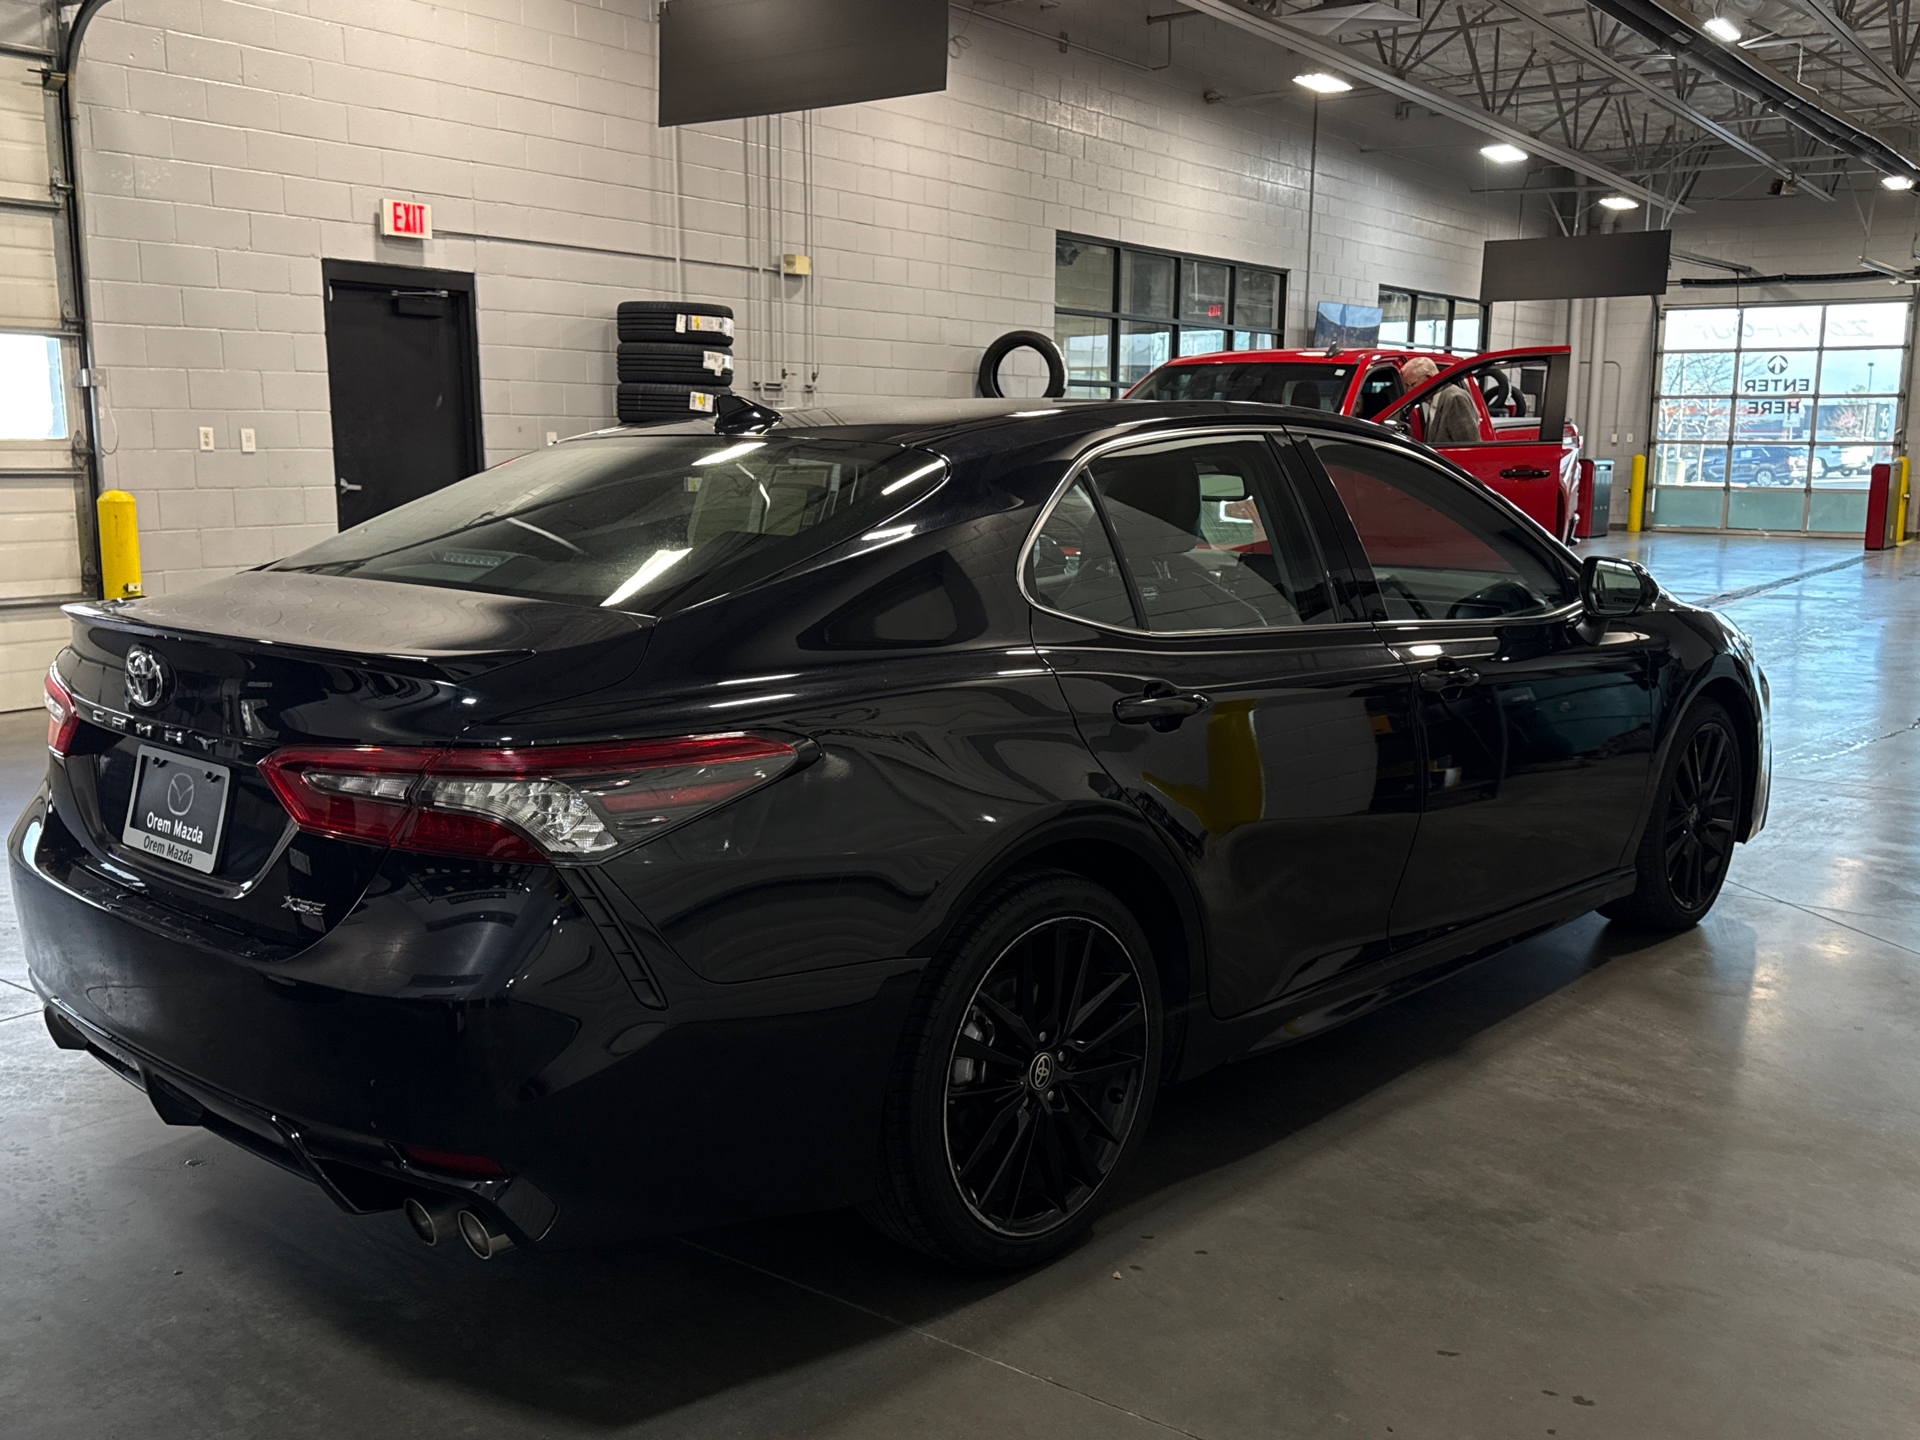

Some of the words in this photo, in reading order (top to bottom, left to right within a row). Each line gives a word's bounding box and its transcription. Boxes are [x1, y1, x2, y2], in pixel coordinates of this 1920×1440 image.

[393, 202, 425, 235] EXIT
[92, 709, 218, 751] CAMRY
[146, 811, 171, 834] Orem
[173, 819, 204, 844] Mazda
[143, 835, 165, 855] Orem
[166, 843, 193, 865] Mazda
[281, 895, 326, 915] XSE
